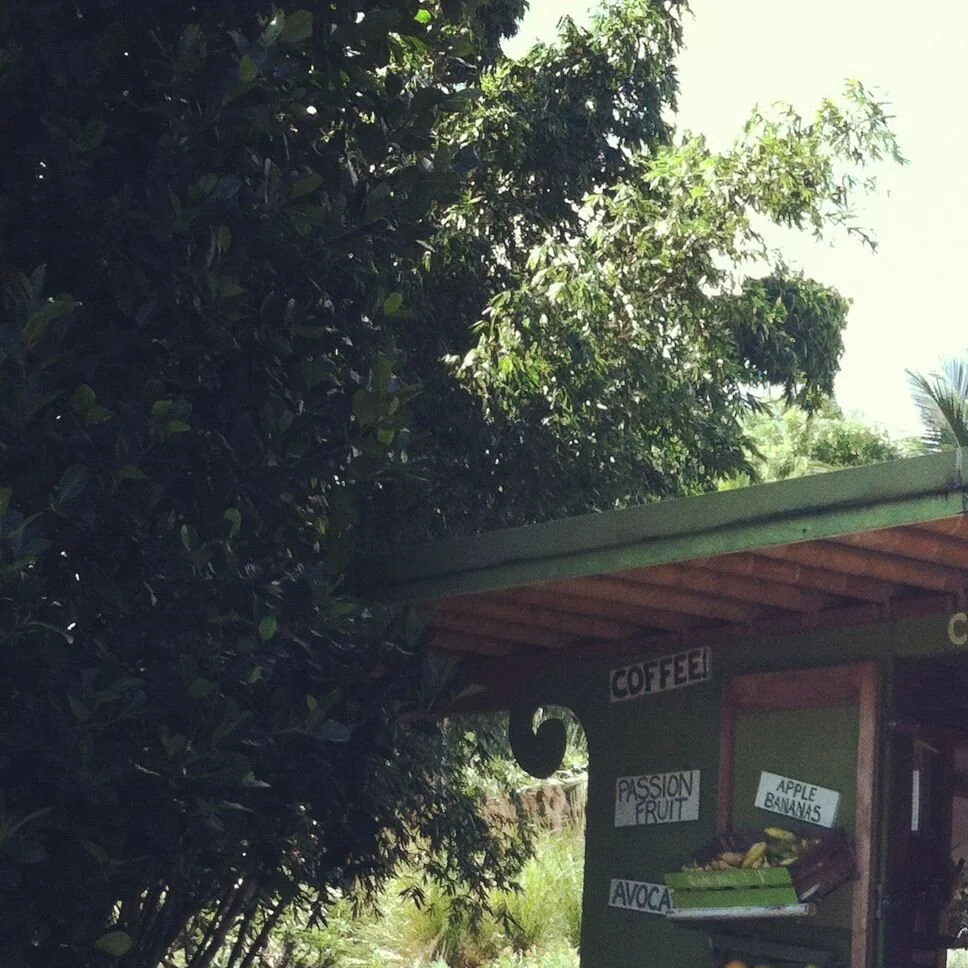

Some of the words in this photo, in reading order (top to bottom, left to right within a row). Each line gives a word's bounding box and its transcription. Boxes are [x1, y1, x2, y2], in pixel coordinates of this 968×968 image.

[611, 647, 708, 699] COFFEE!
[617, 770, 693, 802] PASSION
[775, 778, 818, 803] APPLE
[635, 796, 688, 824] FRUIT
[763, 792, 822, 824] BANANAS
